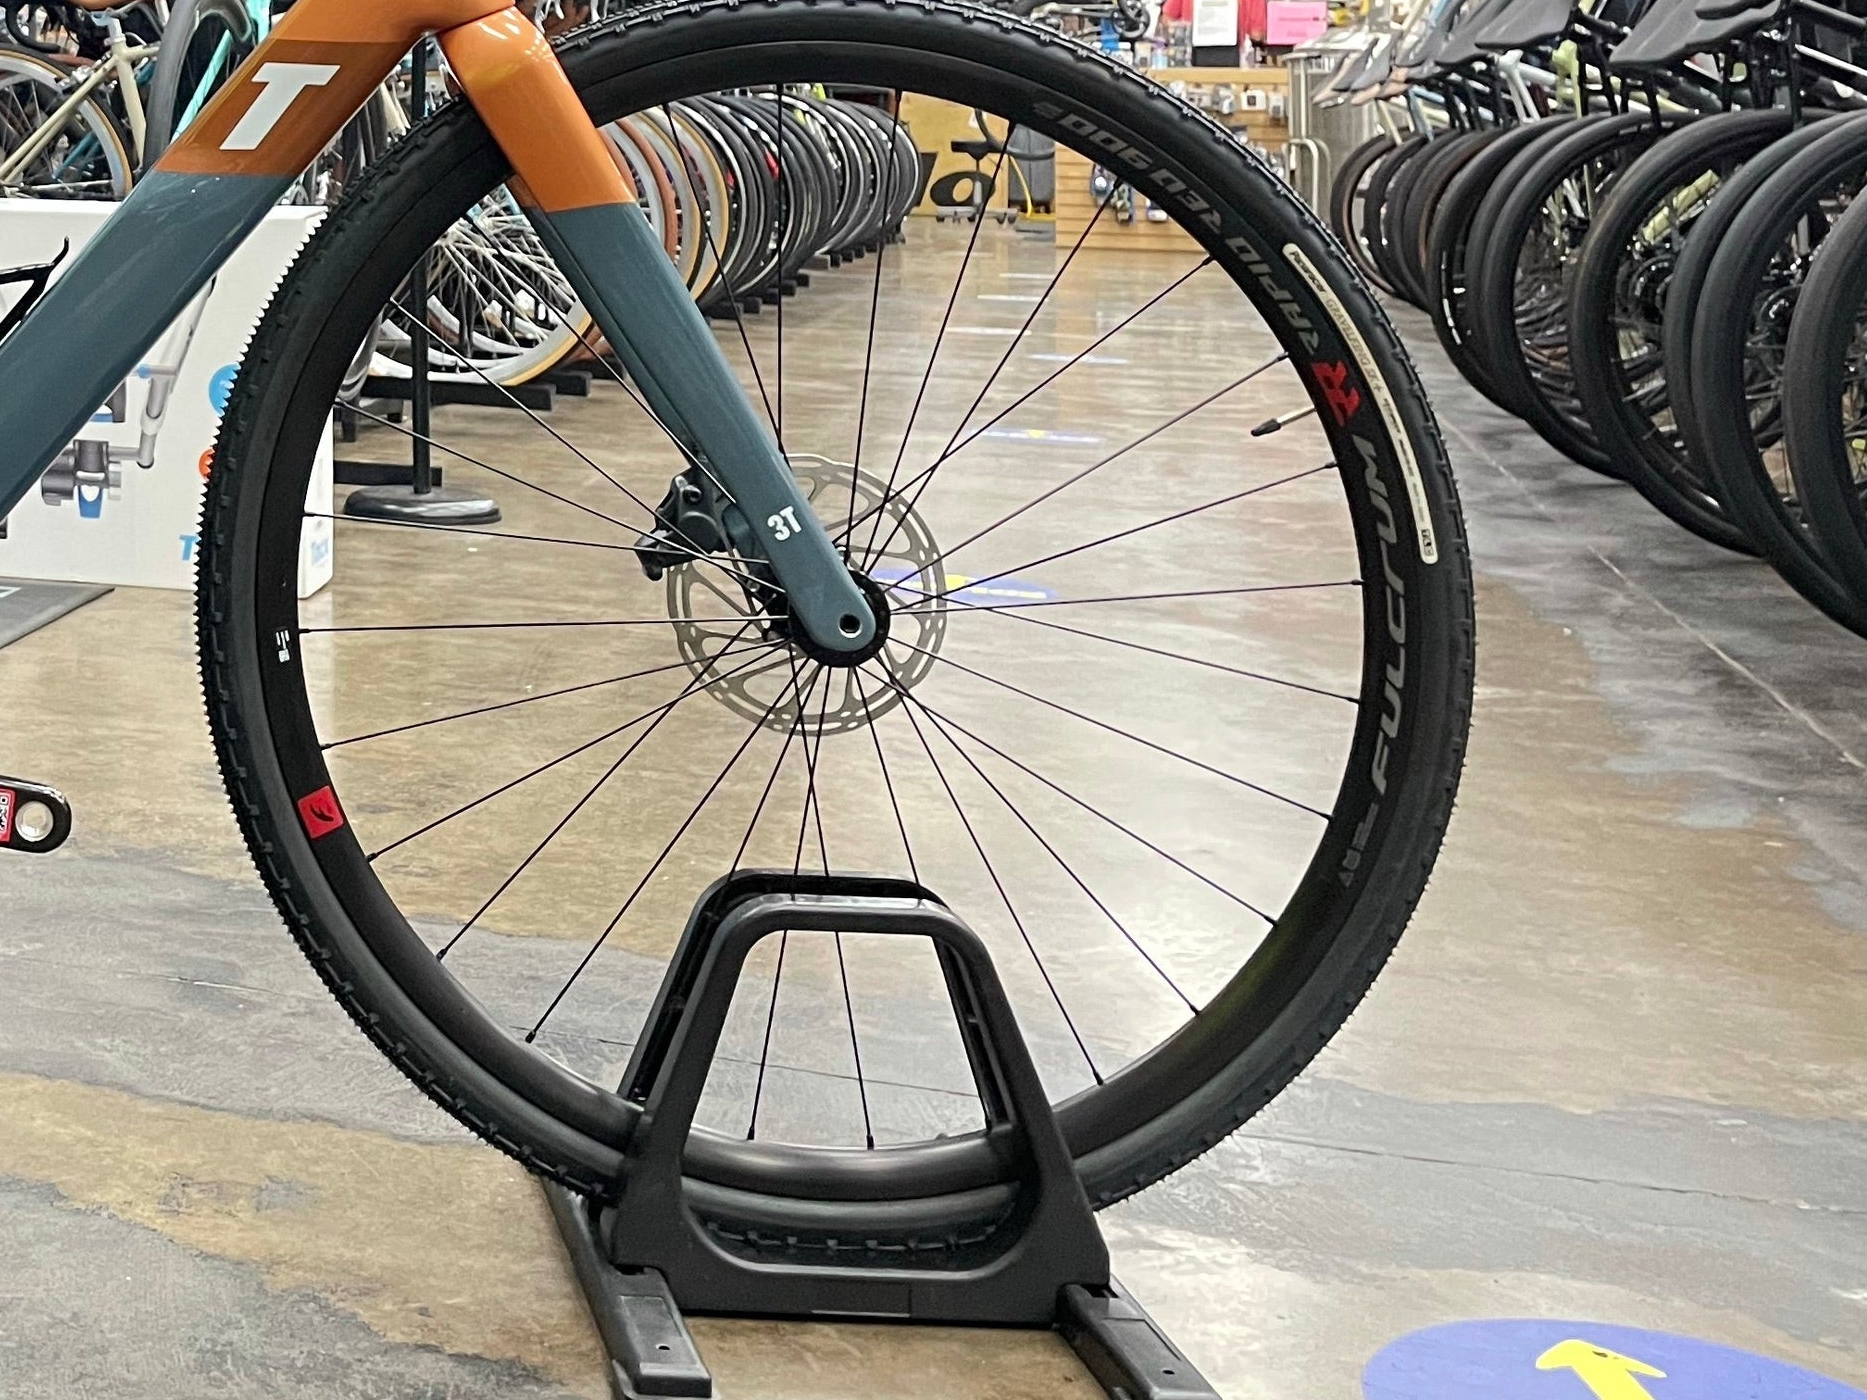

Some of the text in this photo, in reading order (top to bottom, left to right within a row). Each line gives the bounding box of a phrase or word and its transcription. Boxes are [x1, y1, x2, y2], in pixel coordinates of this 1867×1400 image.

[219, 62, 341, 151] T
[1057, 113, 1154, 170] 900
[1148, 168, 1222, 235] RED
[1225, 236, 1319, 356] RAPID
[767, 504, 803, 542] 3T
[1352, 434, 1406, 796] FULCRUM
